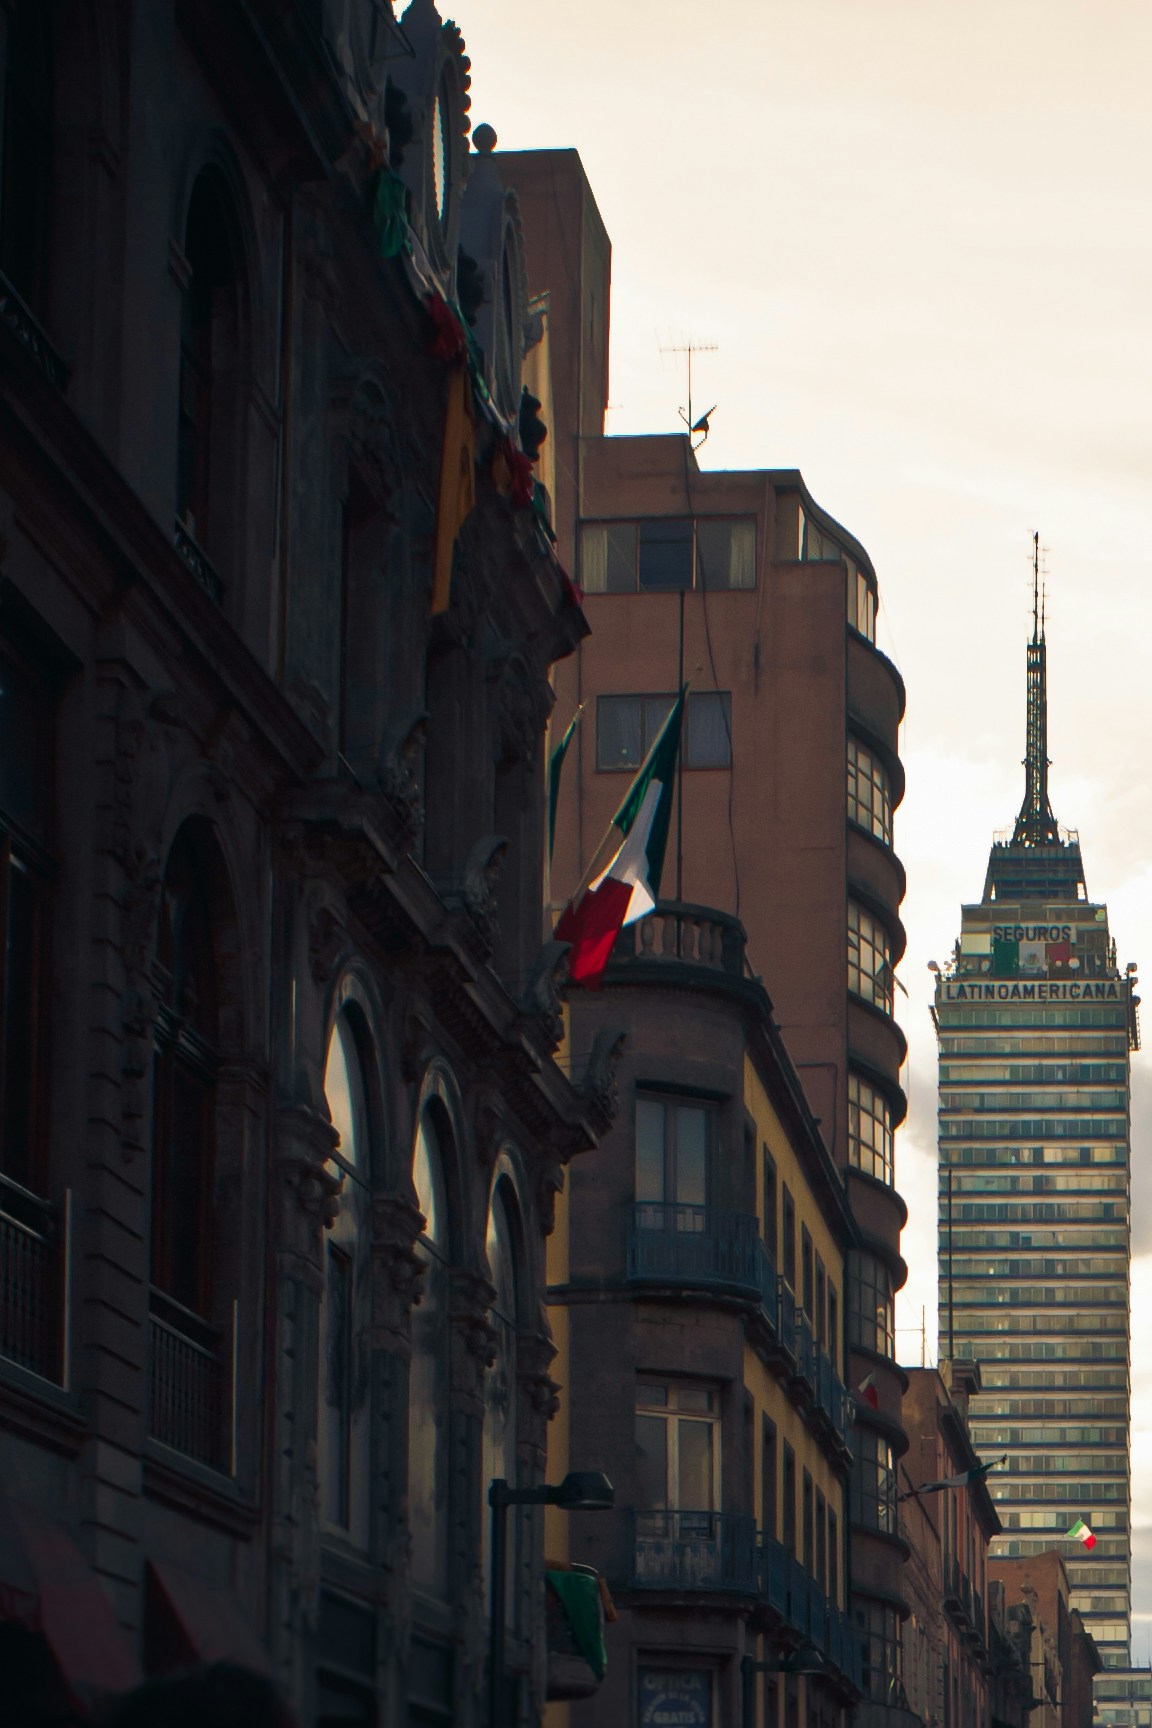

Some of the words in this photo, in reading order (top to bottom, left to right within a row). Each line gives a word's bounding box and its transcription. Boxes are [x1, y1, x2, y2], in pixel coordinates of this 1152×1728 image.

[993, 926, 1071, 941] SEGUROS
[946, 983, 1118, 1000] LATINOAMERICANA
[654, 1712, 696, 1724] GRATIS
